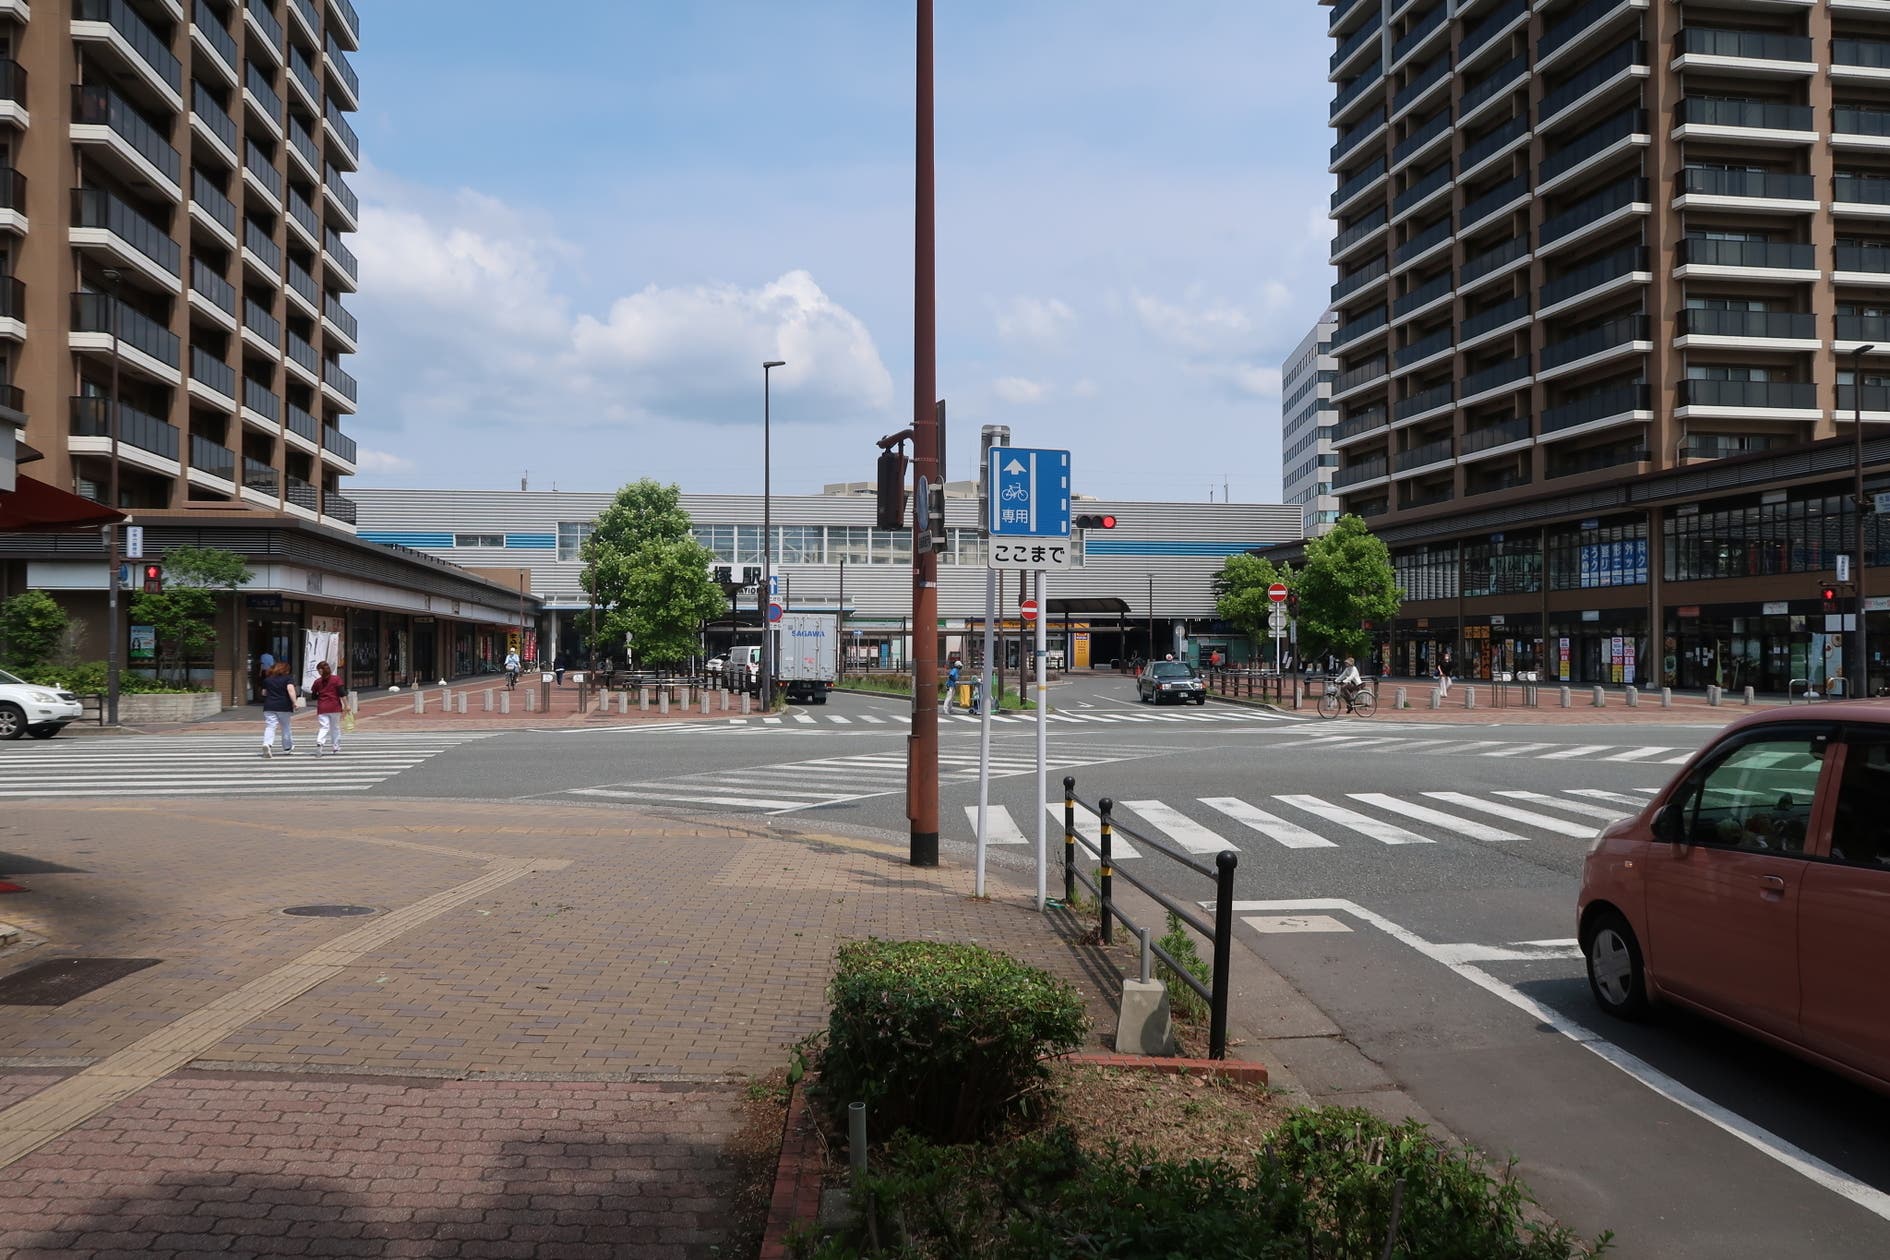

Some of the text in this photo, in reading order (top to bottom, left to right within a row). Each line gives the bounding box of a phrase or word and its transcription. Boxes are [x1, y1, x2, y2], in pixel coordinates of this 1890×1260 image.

[1001, 509, 1029, 524] 専用
[995, 545, 1065, 563] ここまで
[791, 630, 825, 638] SAGAWA
